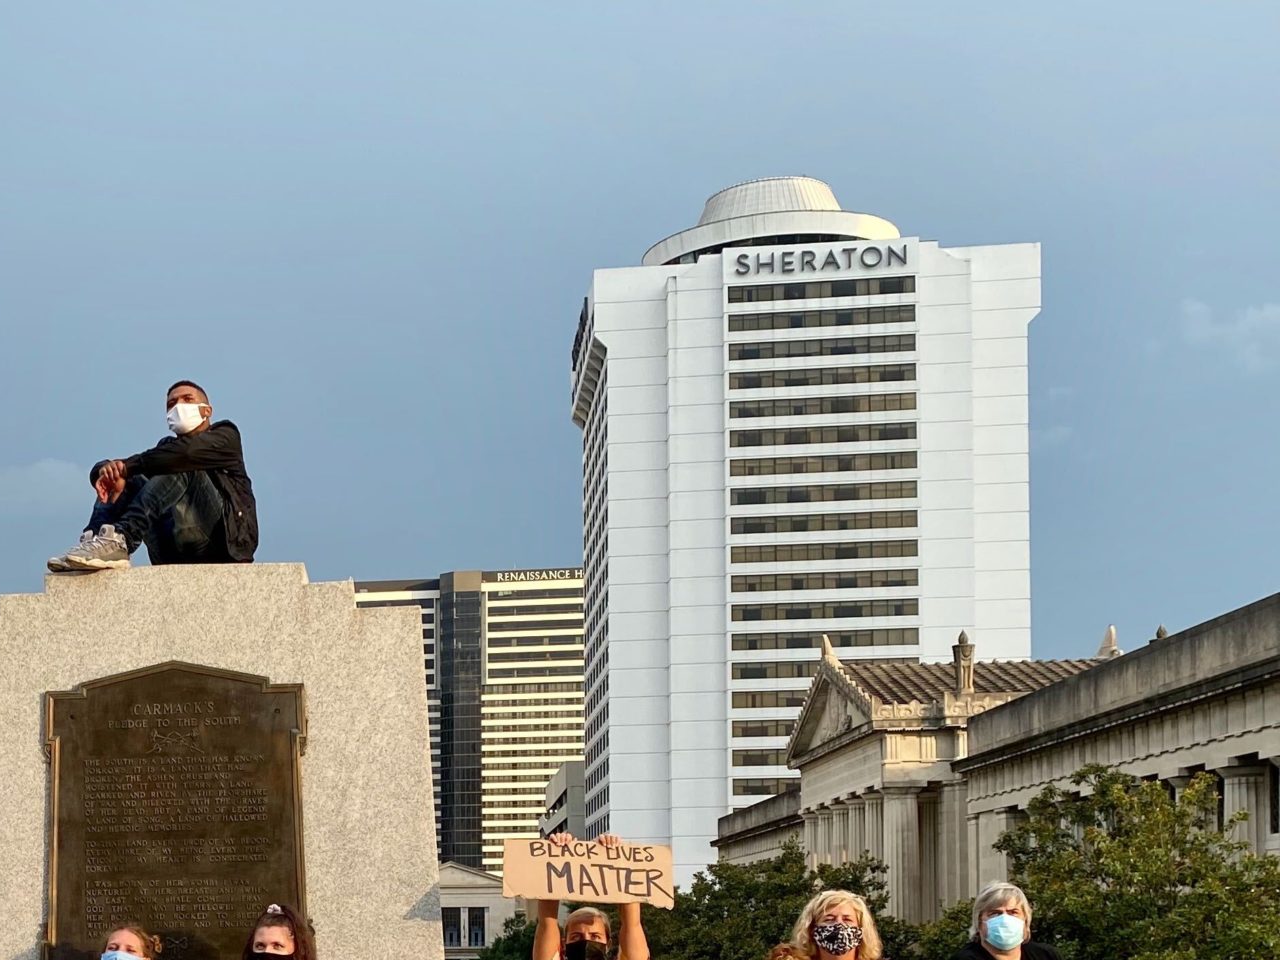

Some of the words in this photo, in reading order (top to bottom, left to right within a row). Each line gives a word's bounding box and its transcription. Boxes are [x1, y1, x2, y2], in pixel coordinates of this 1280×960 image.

[735, 244, 907, 275] SHERATON
[497, 569, 570, 582] RENAISSANCE
[133, 700, 215, 716] CARMACK'S
[157, 718, 169, 728] TO
[177, 717, 197, 727] THE
[205, 716, 241, 726] SOUTH
[529, 841, 598, 860] BLACK
[546, 861, 674, 900] MATTER
